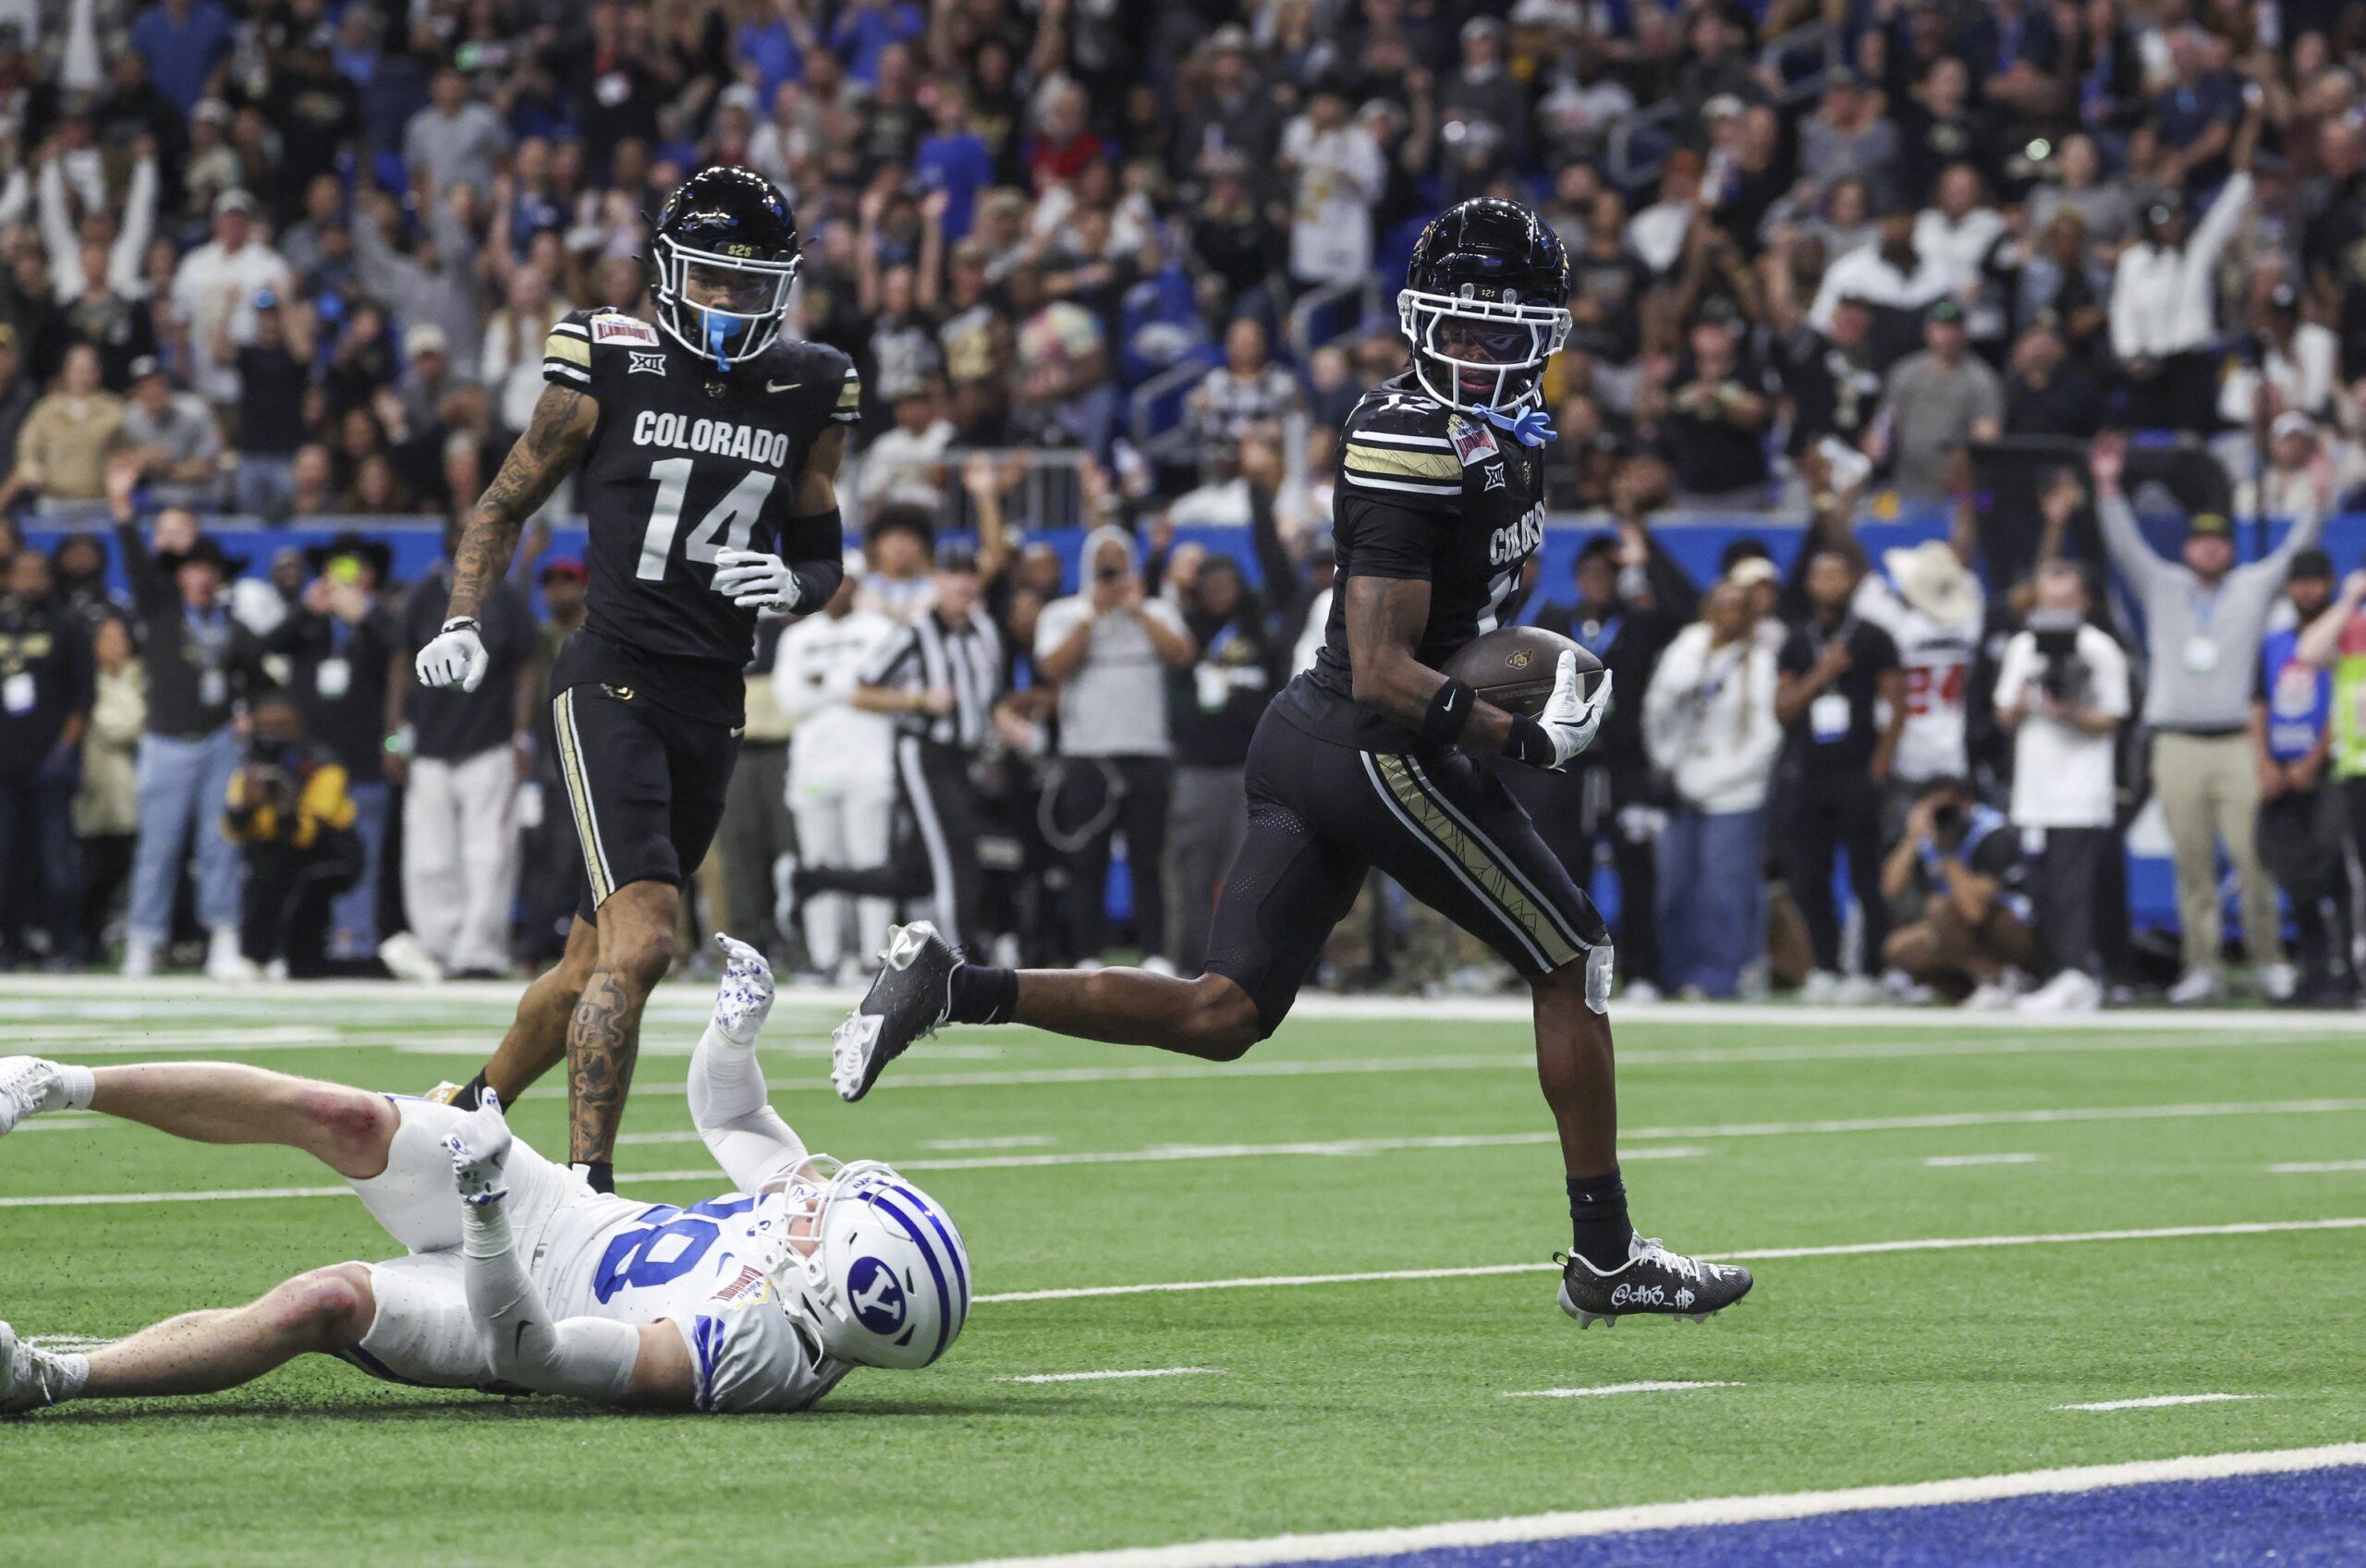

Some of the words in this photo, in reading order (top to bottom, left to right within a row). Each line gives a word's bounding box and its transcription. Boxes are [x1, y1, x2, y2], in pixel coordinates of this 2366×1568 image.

[633, 411, 788, 468] COLORADO
[636, 457, 775, 590] 14
[852, 1265, 900, 1319] Y
